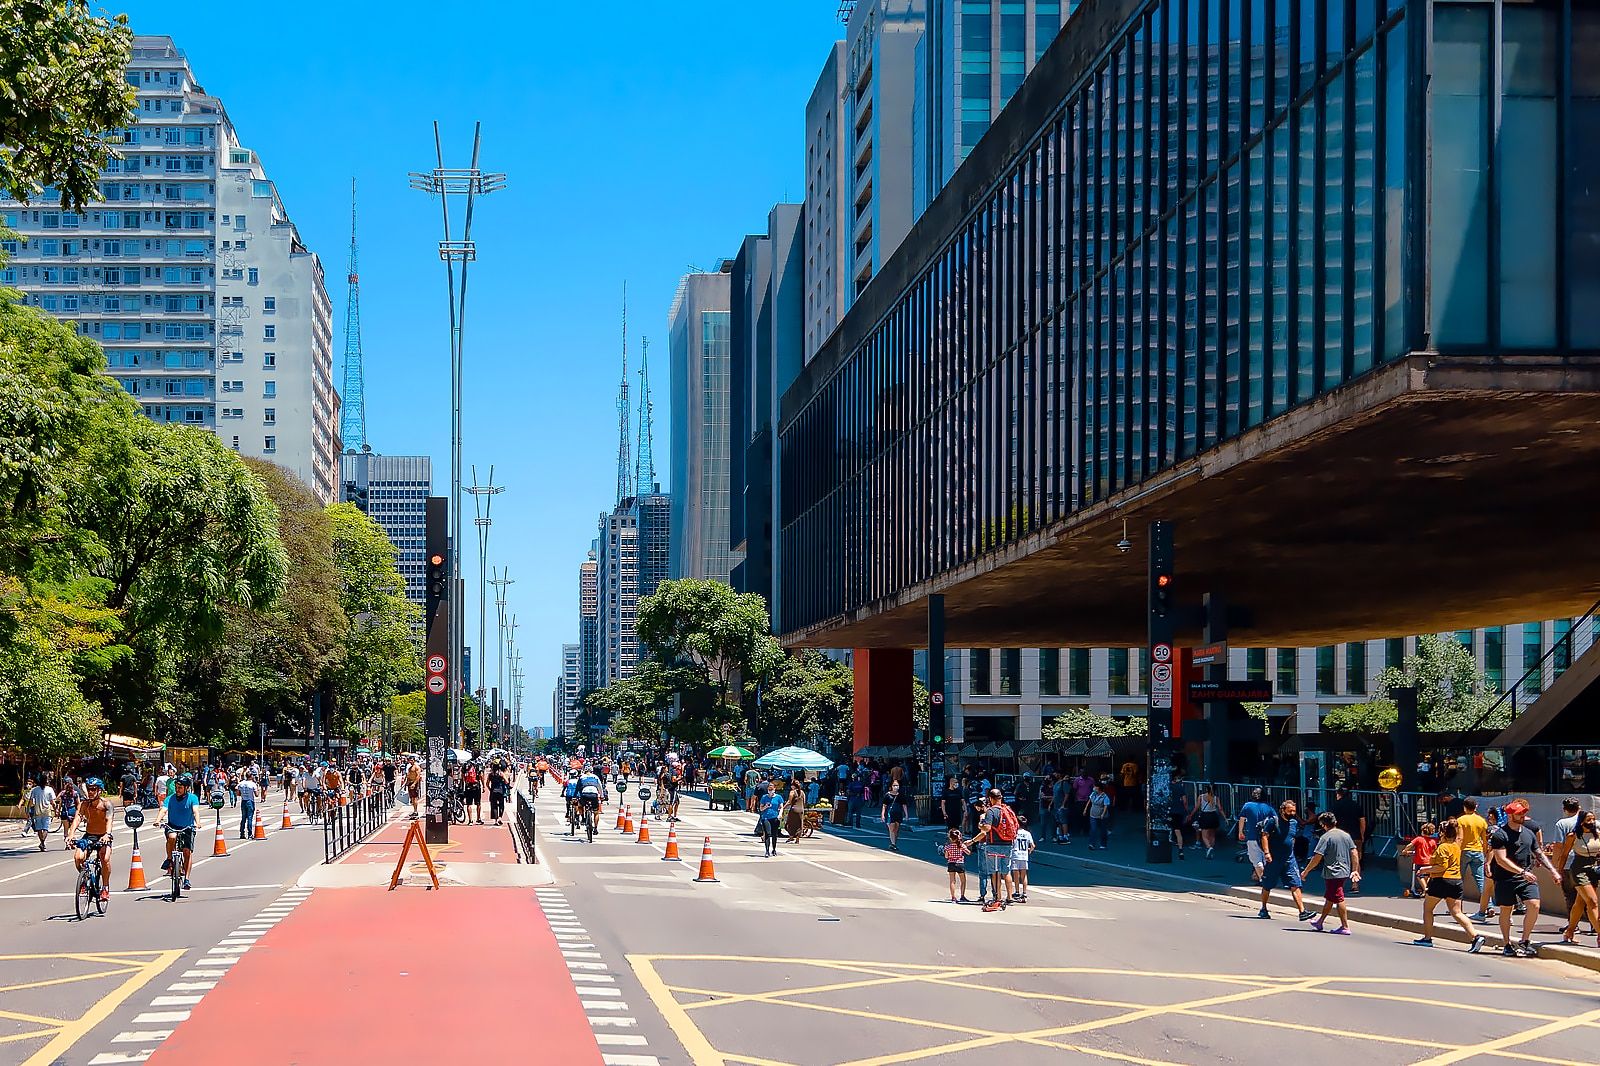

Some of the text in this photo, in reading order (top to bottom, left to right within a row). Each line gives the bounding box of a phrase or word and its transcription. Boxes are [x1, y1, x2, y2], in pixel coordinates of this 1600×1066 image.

[1155, 648, 1168, 656] 50
[430, 659, 444, 668] 50
[1017, 838, 1027, 851] 10
